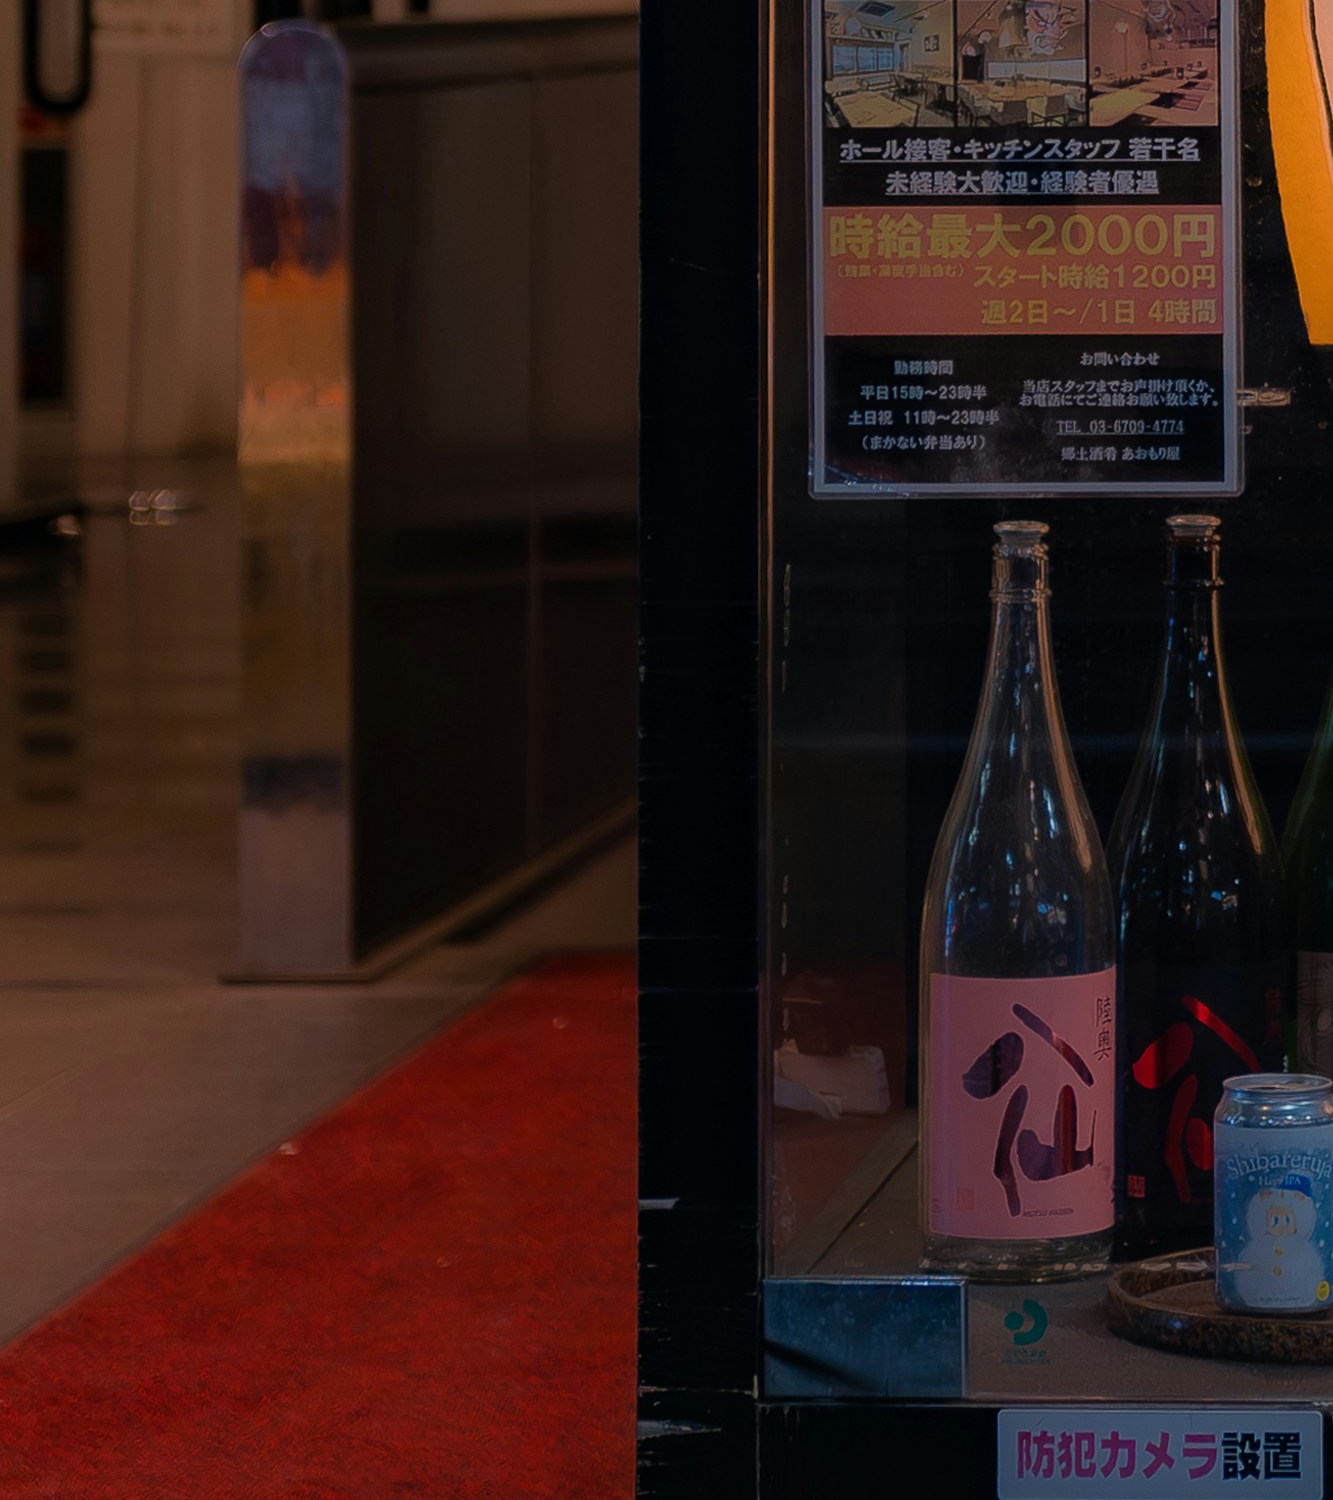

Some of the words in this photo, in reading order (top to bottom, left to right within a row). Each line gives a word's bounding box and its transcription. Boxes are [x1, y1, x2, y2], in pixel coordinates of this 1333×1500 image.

[829, 213, 1215, 258] 時給最大2000円
[974, 264, 1217, 290] スタート時給1200円
[893, 359, 954, 376] 勤務時間
[1080, 352, 1160, 367] お問い合わせ
[848, 410, 894, 426] 土日祝
[1056, 419, 1081, 434] TEL
[1089, 419, 1185, 435] 03-6709-4774
[1017, 1430, 1302, 1480] 防犯カメラ設置
